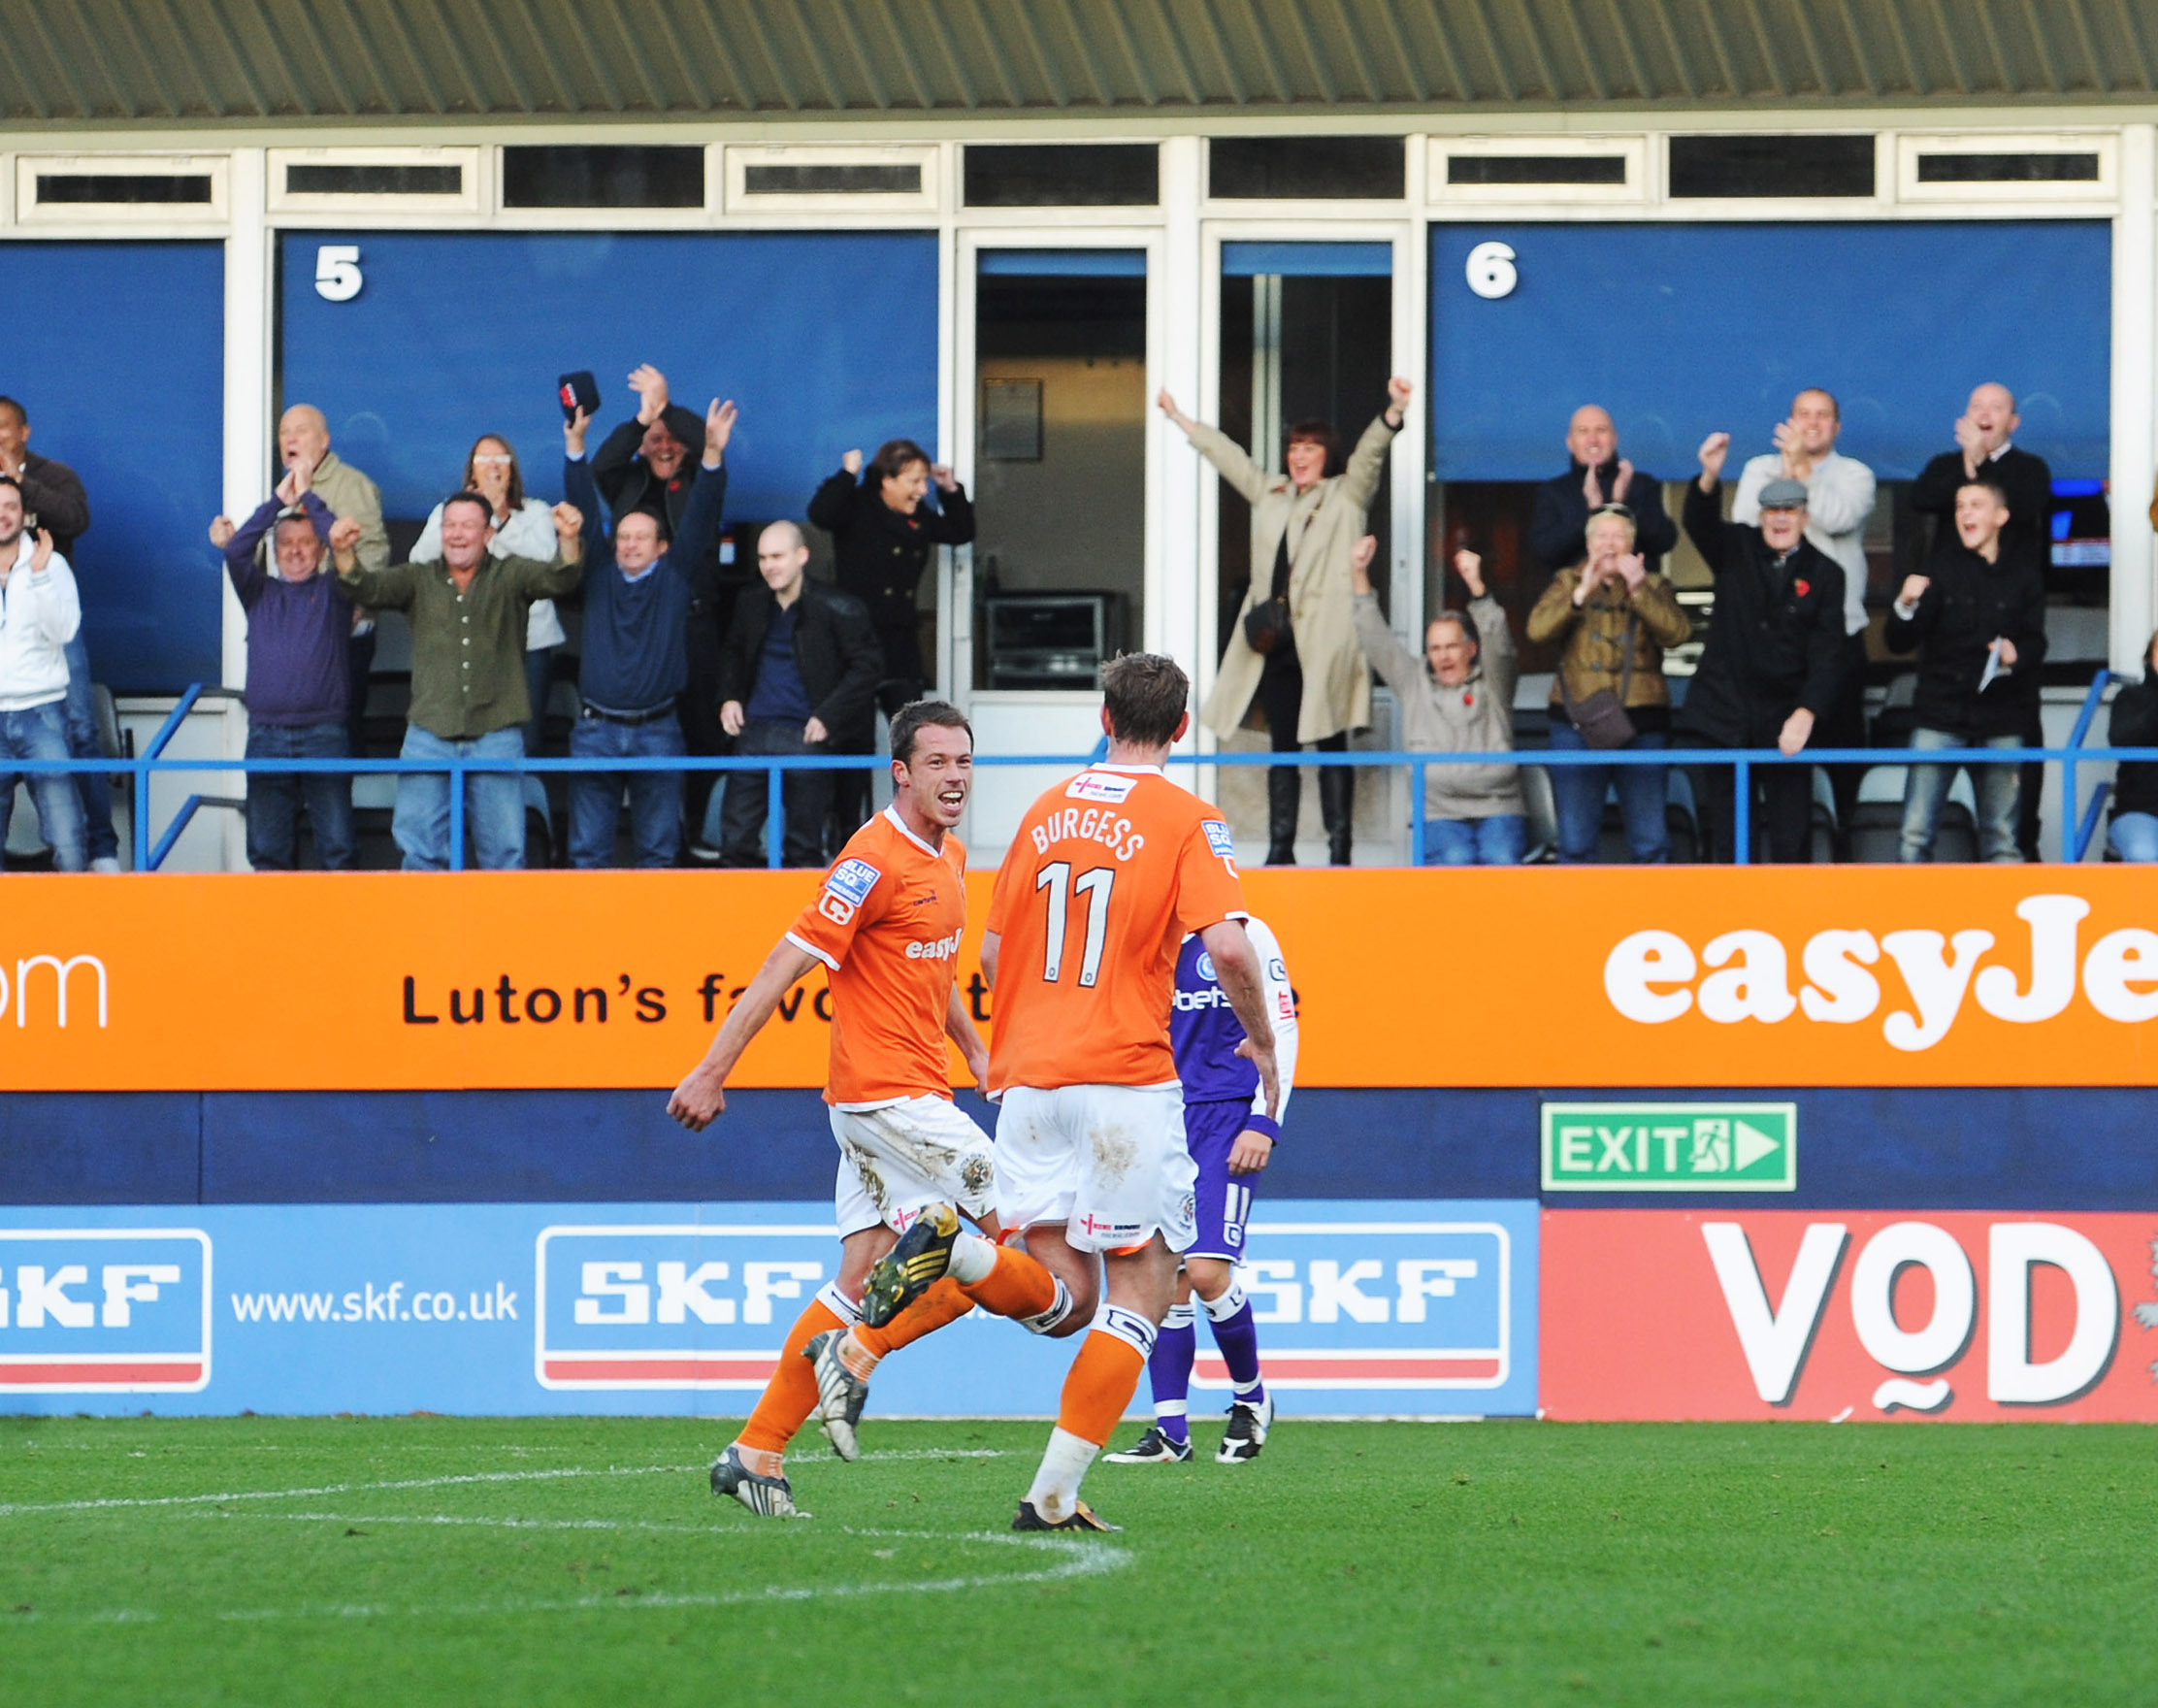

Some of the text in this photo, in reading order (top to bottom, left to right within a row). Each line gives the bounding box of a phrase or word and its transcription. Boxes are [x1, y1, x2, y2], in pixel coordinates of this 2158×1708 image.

[314, 245, 363, 302] 5
[1465, 242, 1517, 299] 6
[1030, 807, 1145, 862] BURGESS
[842, 860, 877, 883] BLUE
[1036, 860, 1116, 988] 11
[0, 954, 108, 1029] m
[404, 973, 668, 1024] Luton's
[1603, 894, 2158, 1051] easyJe
[1559, 1126, 1689, 1172] EXIT
[0, 1265, 180, 1329] KF
[230, 1281, 519, 1323] www.skf.co.uk
[573, 1261, 823, 1325] SKF
[1235, 1259, 1478, 1324] SKF
